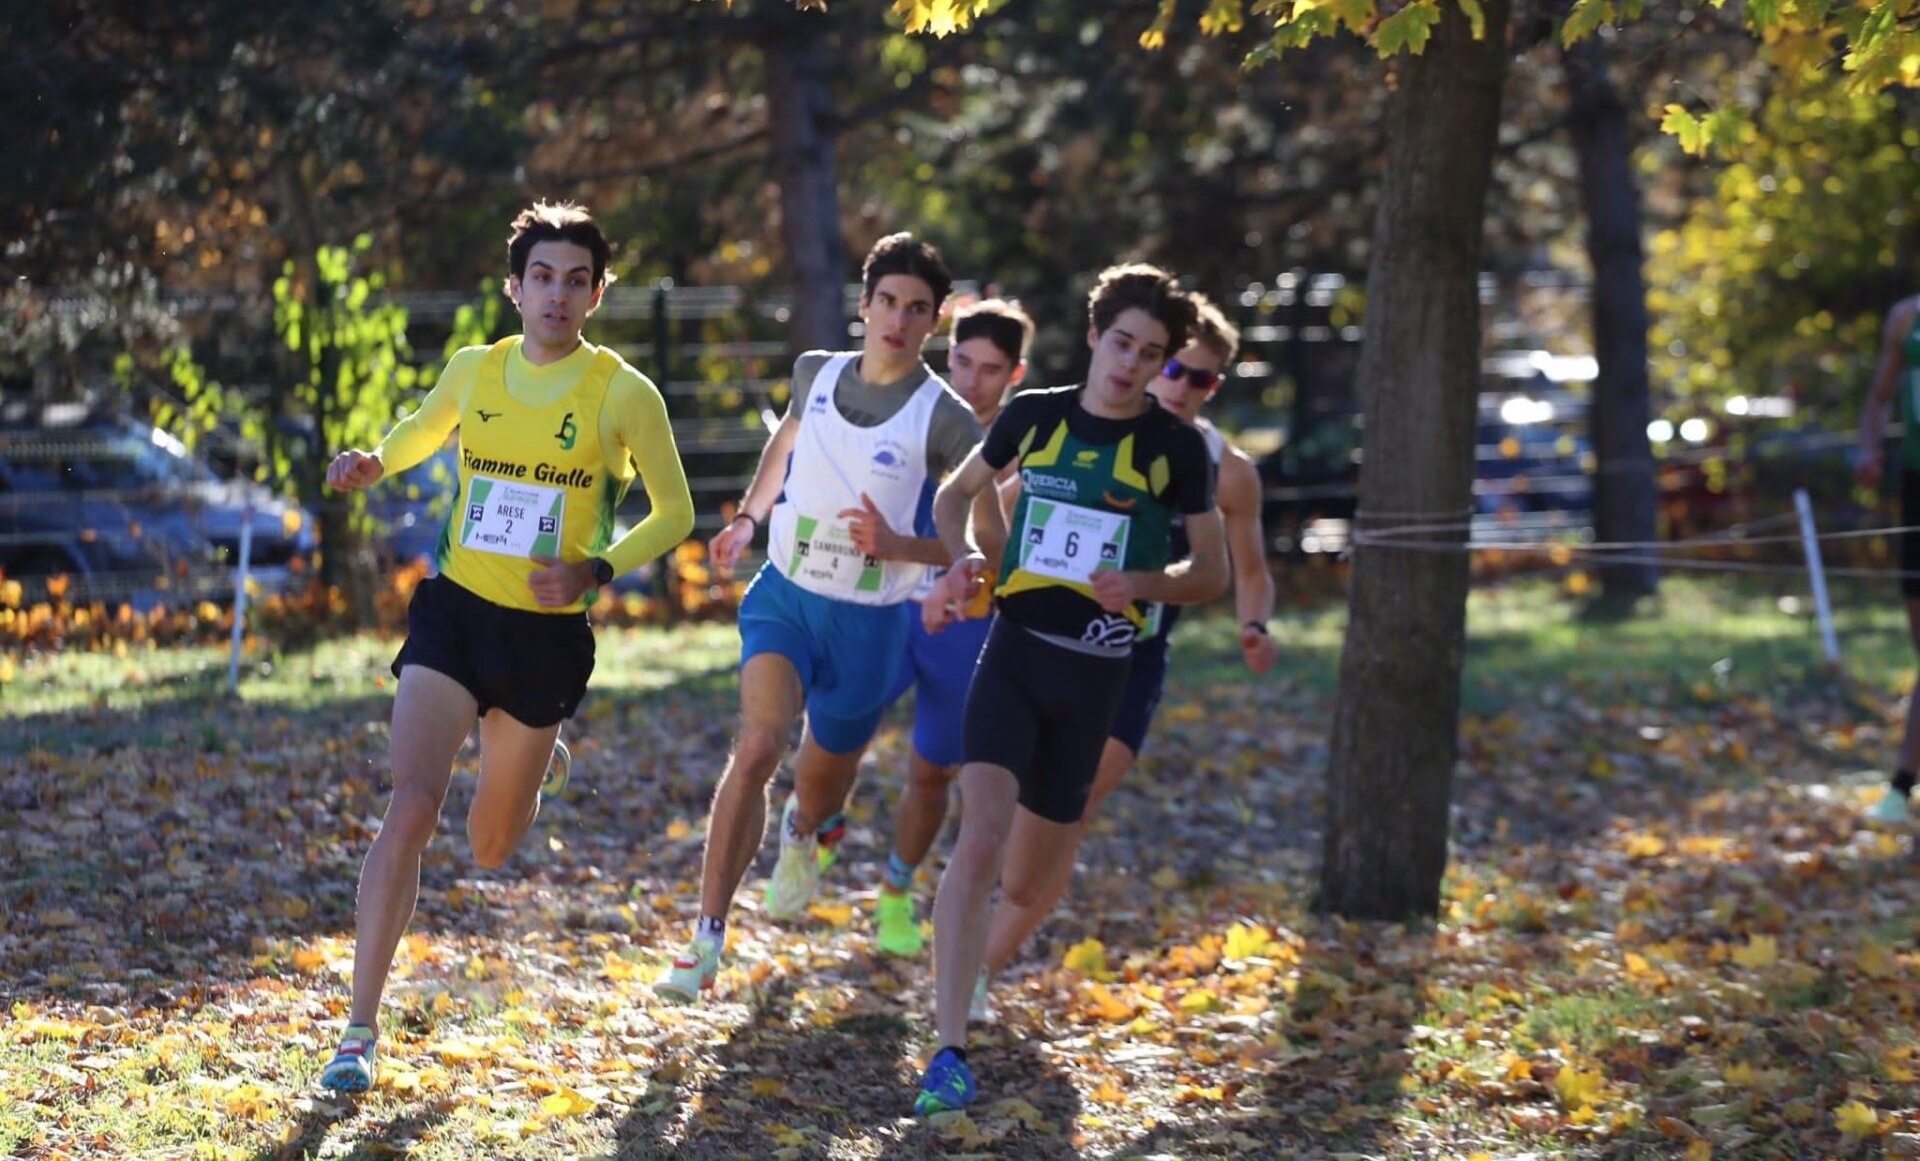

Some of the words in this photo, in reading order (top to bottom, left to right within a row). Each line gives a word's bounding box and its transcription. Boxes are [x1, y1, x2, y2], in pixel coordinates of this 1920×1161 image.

[463, 448, 527, 477] Fiamme
[534, 463, 593, 488] Gialle
[1022, 468, 1078, 493] QUERCIA
[497, 504, 525, 519] ARESE
[505, 519, 513, 534] 2
[1065, 531, 1080, 558] 6
